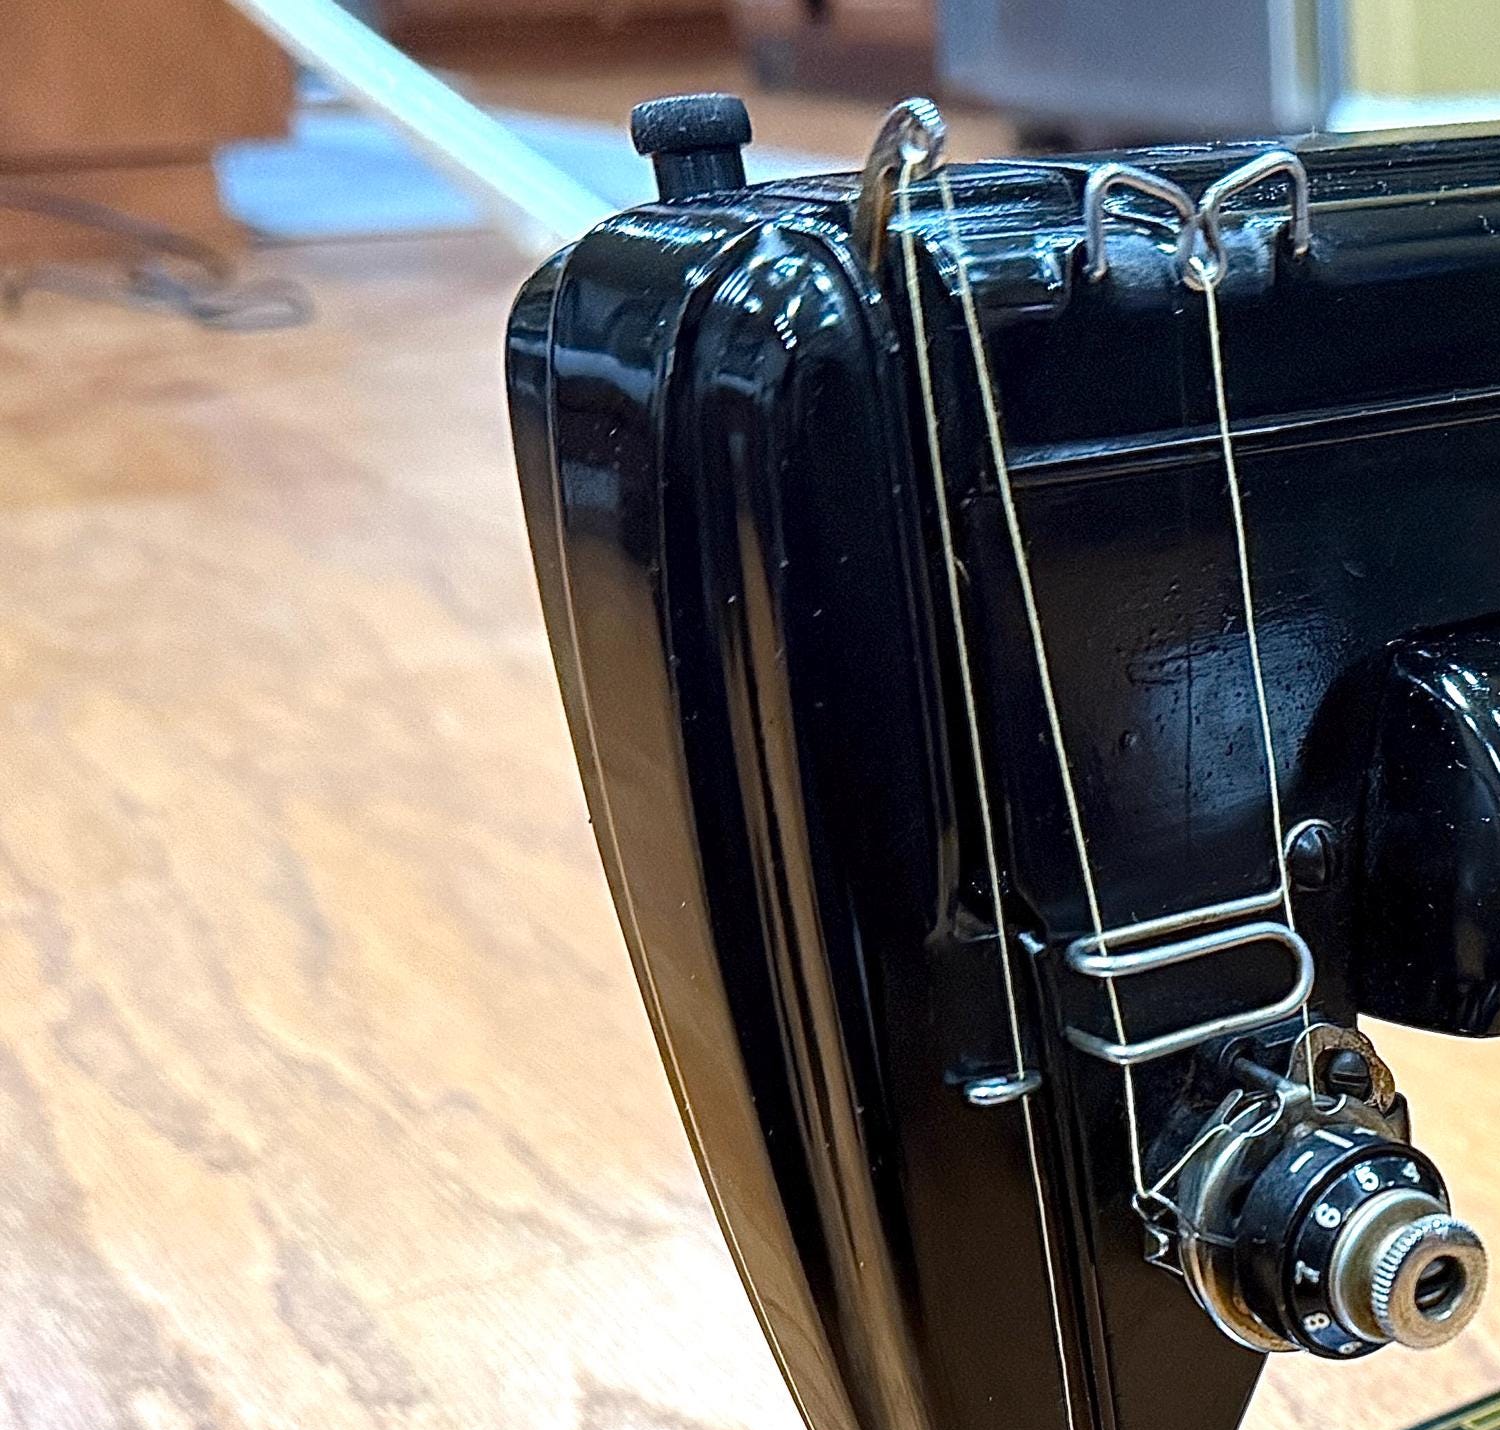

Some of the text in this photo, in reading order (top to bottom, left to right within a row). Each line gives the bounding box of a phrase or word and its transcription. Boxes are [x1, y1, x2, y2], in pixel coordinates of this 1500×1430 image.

[1355, 1163, 1380, 1192] 5
[1402, 1161, 1421, 1184] 4
[1315, 1202, 1342, 1228] 6
[1294, 1260, 1321, 1284] 7
[1303, 1311, 1332, 1333] 8
